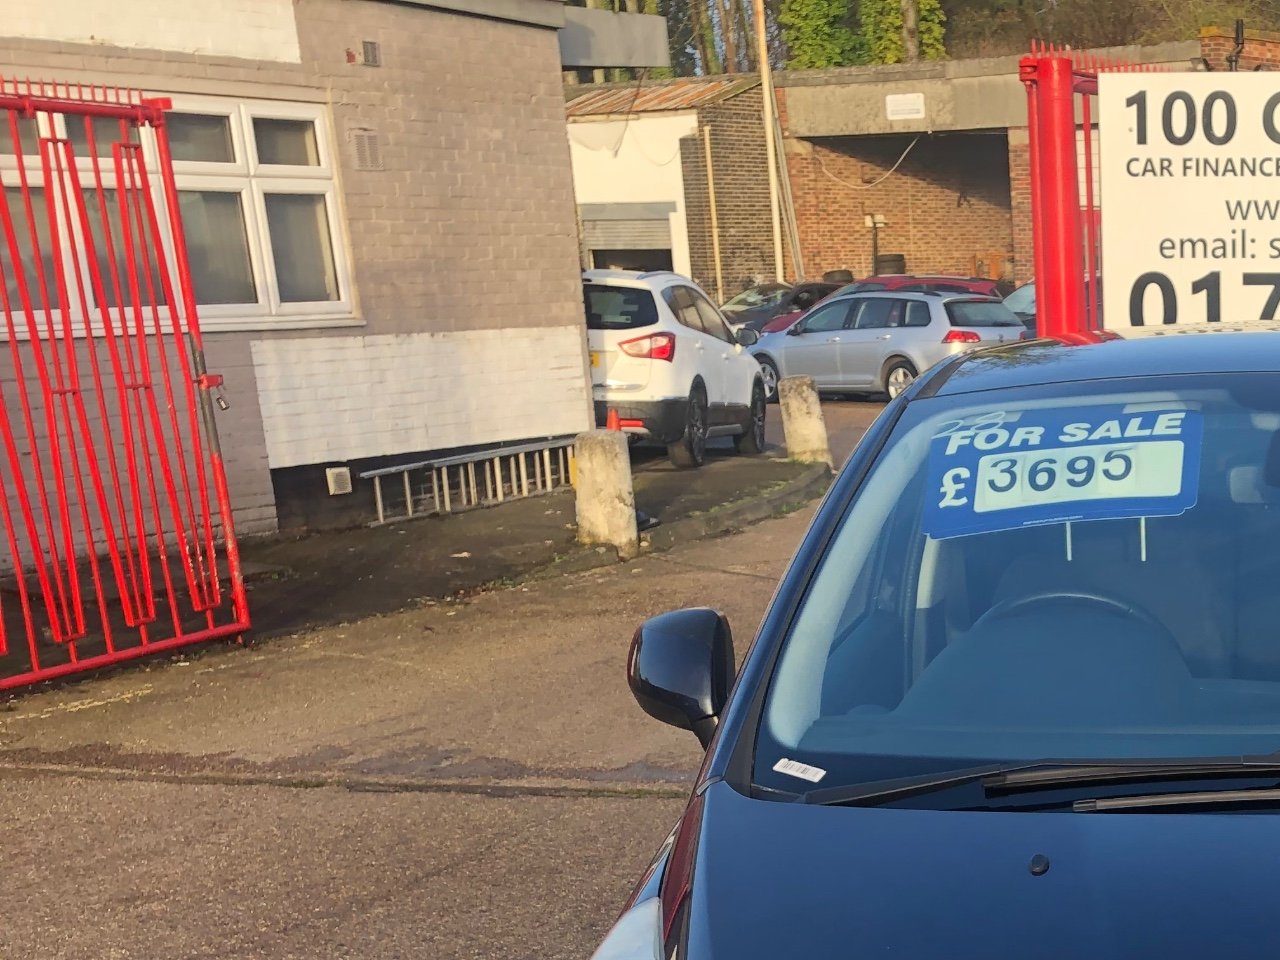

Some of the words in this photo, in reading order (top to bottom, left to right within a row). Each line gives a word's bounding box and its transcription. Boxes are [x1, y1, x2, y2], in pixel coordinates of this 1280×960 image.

[1125, 90, 1237, 146] 100
[1126, 157, 1175, 178] CAR
[1159, 228, 1257, 260] email:
[944, 427, 1045, 455] FOR
[1058, 412, 1186, 443] SALE
